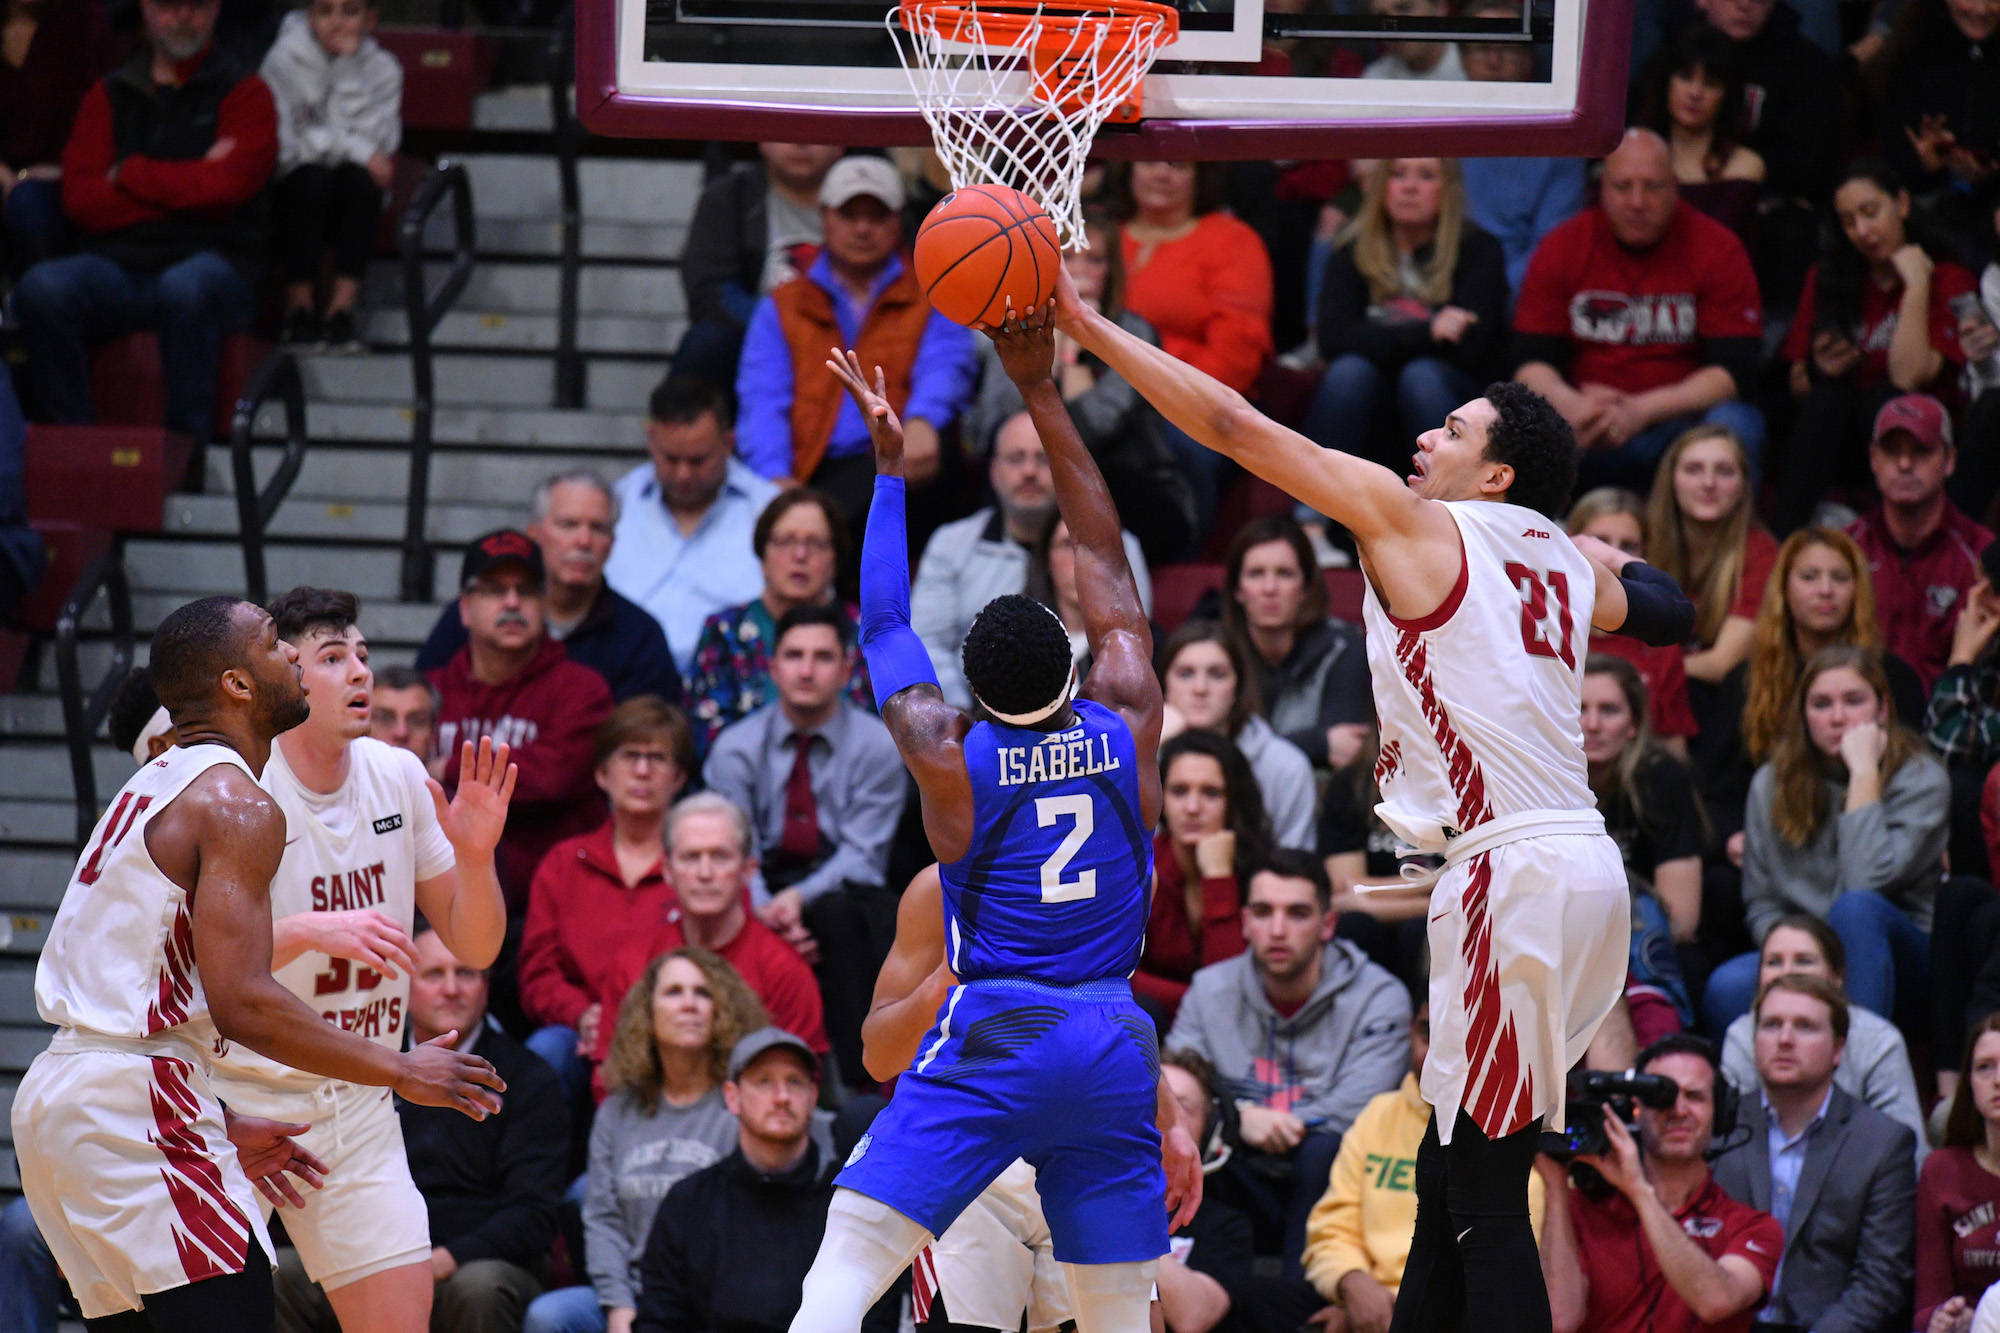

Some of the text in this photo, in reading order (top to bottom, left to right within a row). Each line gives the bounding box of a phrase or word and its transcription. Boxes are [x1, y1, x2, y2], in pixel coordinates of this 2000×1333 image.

[1521, 528, 1551, 540] A10
[1504, 560, 1577, 674] 21
[997, 733, 1120, 787] ISABELL
[1038, 728, 1085, 745] A10
[1034, 793, 1097, 904] 2
[310, 860, 386, 912] SAINT
[1365, 1152, 1417, 1192] FIE
